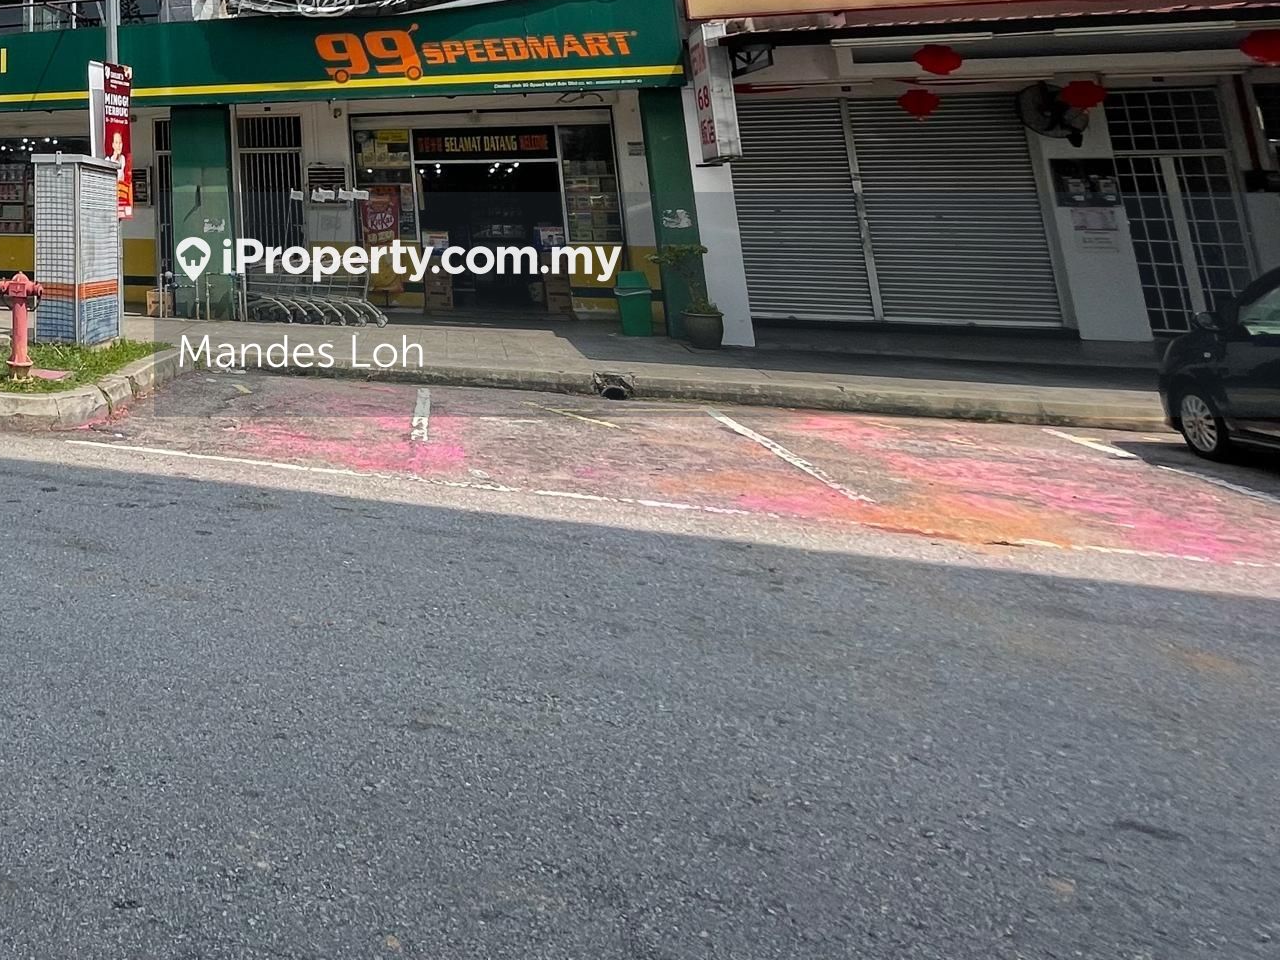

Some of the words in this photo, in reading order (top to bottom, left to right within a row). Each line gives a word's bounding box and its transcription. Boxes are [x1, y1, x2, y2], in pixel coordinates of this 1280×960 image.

[315, 23, 424, 83] 99
[422, 31, 633, 65] SPEEDMART
[445, 136, 481, 152] SELAMAT
[483, 135, 517, 152] DATANG
